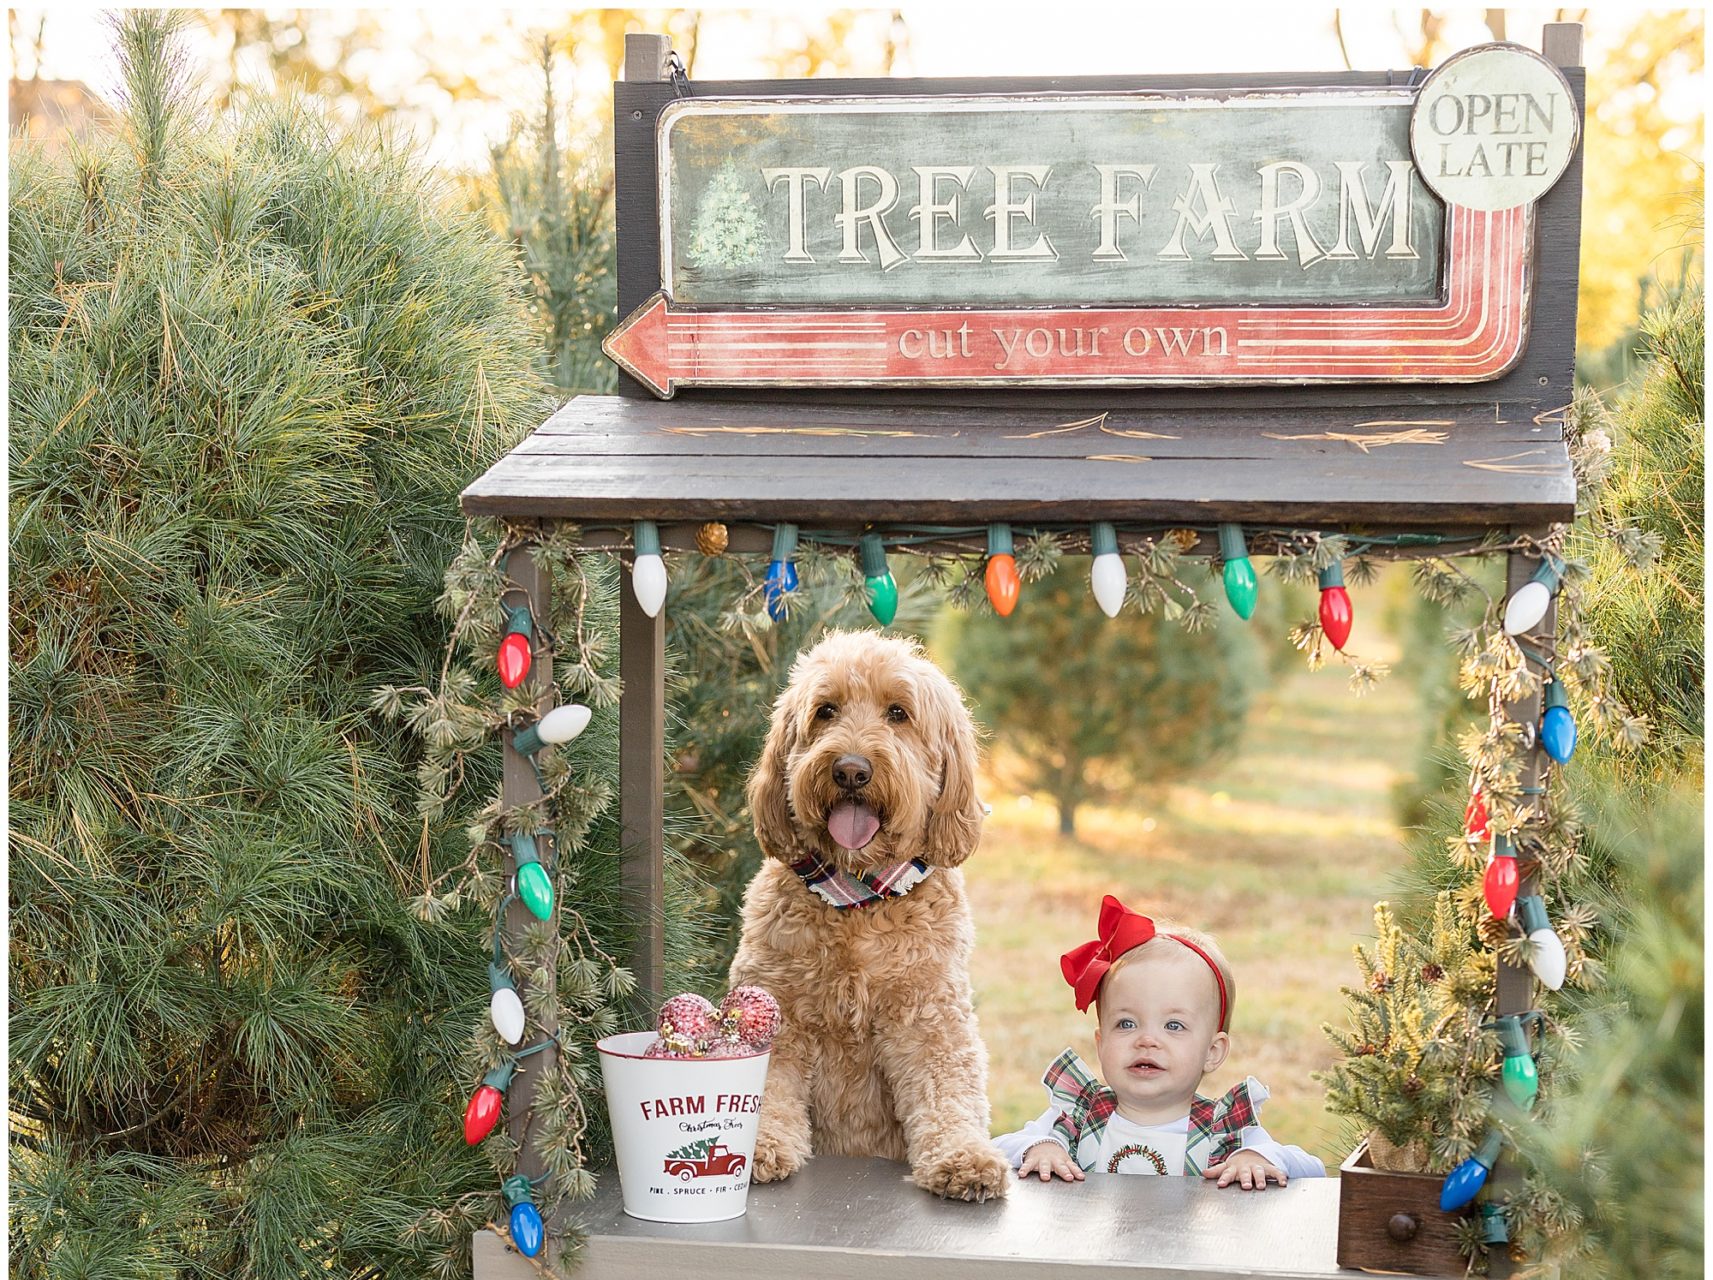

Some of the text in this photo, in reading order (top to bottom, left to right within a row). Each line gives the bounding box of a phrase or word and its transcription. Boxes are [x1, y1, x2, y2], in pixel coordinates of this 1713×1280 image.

[1428, 91, 1557, 137] OPEN
[1438, 141, 1549, 178] LATE
[760, 160, 1420, 272] TREE FARM
[897, 322, 1232, 370] cut your own
[640, 1095, 705, 1121] FARM
[673, 1187, 706, 1195] SPRUCE
[716, 1185, 727, 1194] FIR
